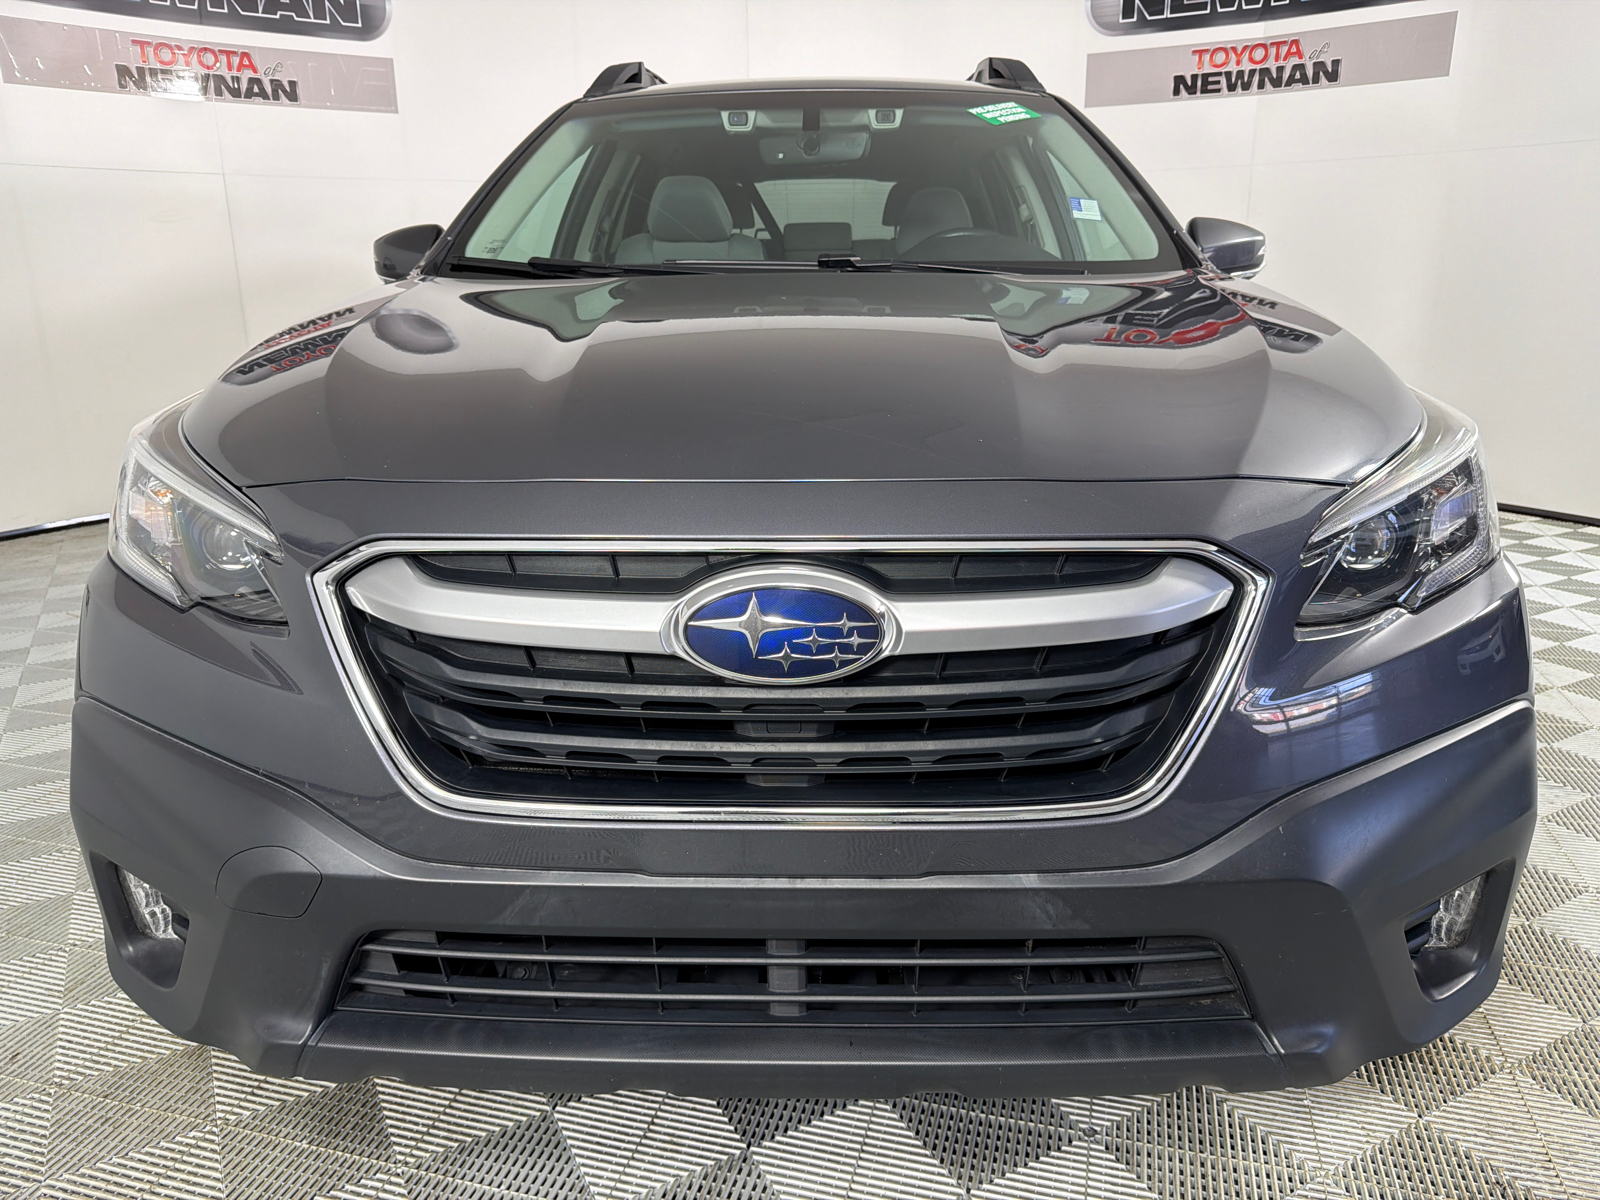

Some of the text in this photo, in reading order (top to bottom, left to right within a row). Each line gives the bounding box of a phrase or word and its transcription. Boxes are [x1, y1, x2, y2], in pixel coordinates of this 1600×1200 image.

[130, 38, 283, 77] TOYOTA of
[1191, 38, 1331, 71] TOYOTA of
[1172, 59, 1343, 97] NEWNAN
